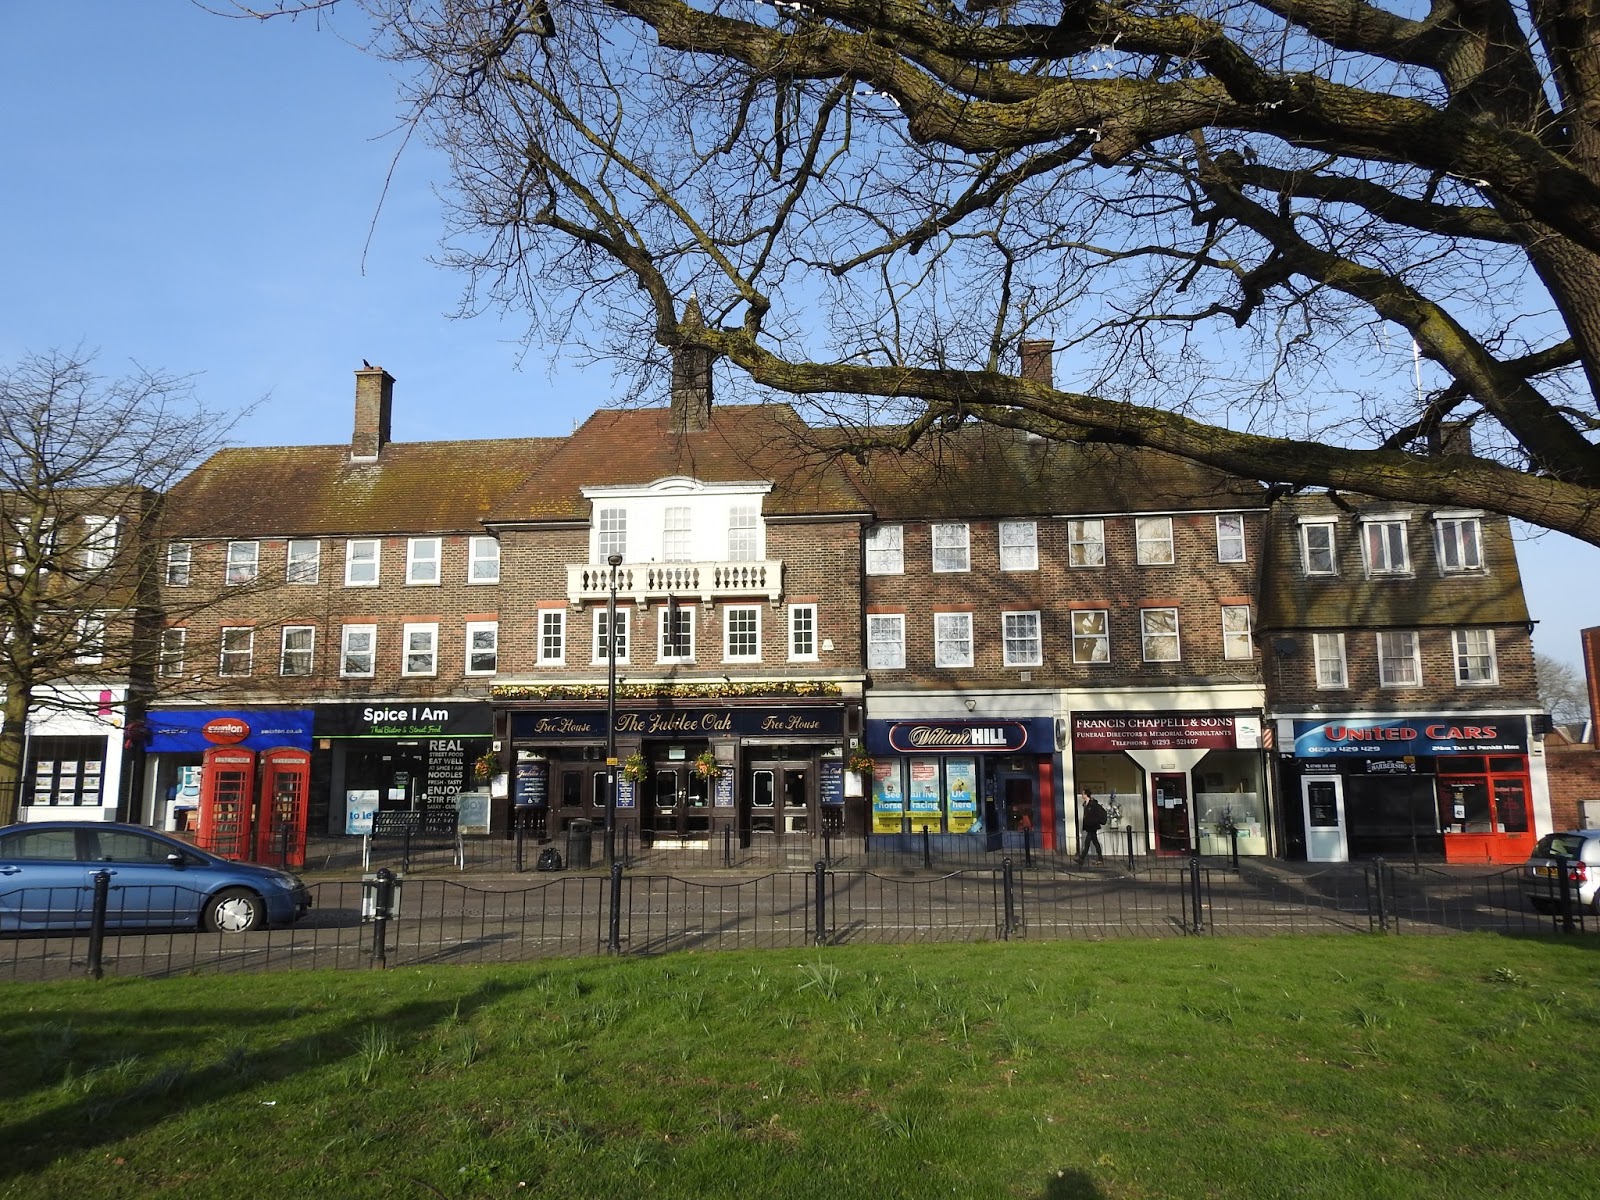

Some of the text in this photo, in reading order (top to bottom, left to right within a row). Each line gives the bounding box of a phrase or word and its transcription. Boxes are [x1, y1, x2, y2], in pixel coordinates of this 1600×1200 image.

[363, 707, 449, 724] Spice I Am
[207, 723, 243, 734] swinton
[557, 717, 592, 733] House
[614, 713, 732, 733] The Jubilee Oak
[761, 715, 820, 731] Free House
[1076, 717, 1233, 729] FRANCIS CHAPPELL & SONS
[427, 724, 442, 734] Food
[1425, 724, 1498, 740] CARS
[908, 726, 1007, 747] William HILL
[429, 740, 465, 751] REAL
[1371, 762, 1408, 771] BARBERSHO
[428, 771, 463, 779] NOODLES
[427, 786, 462, 795] ENJOY
[884, 790, 965, 799] See all live UK
[427, 796, 445, 804] STIR
[878, 801, 972, 810] horse racing here
[349, 811, 374, 820] to le
